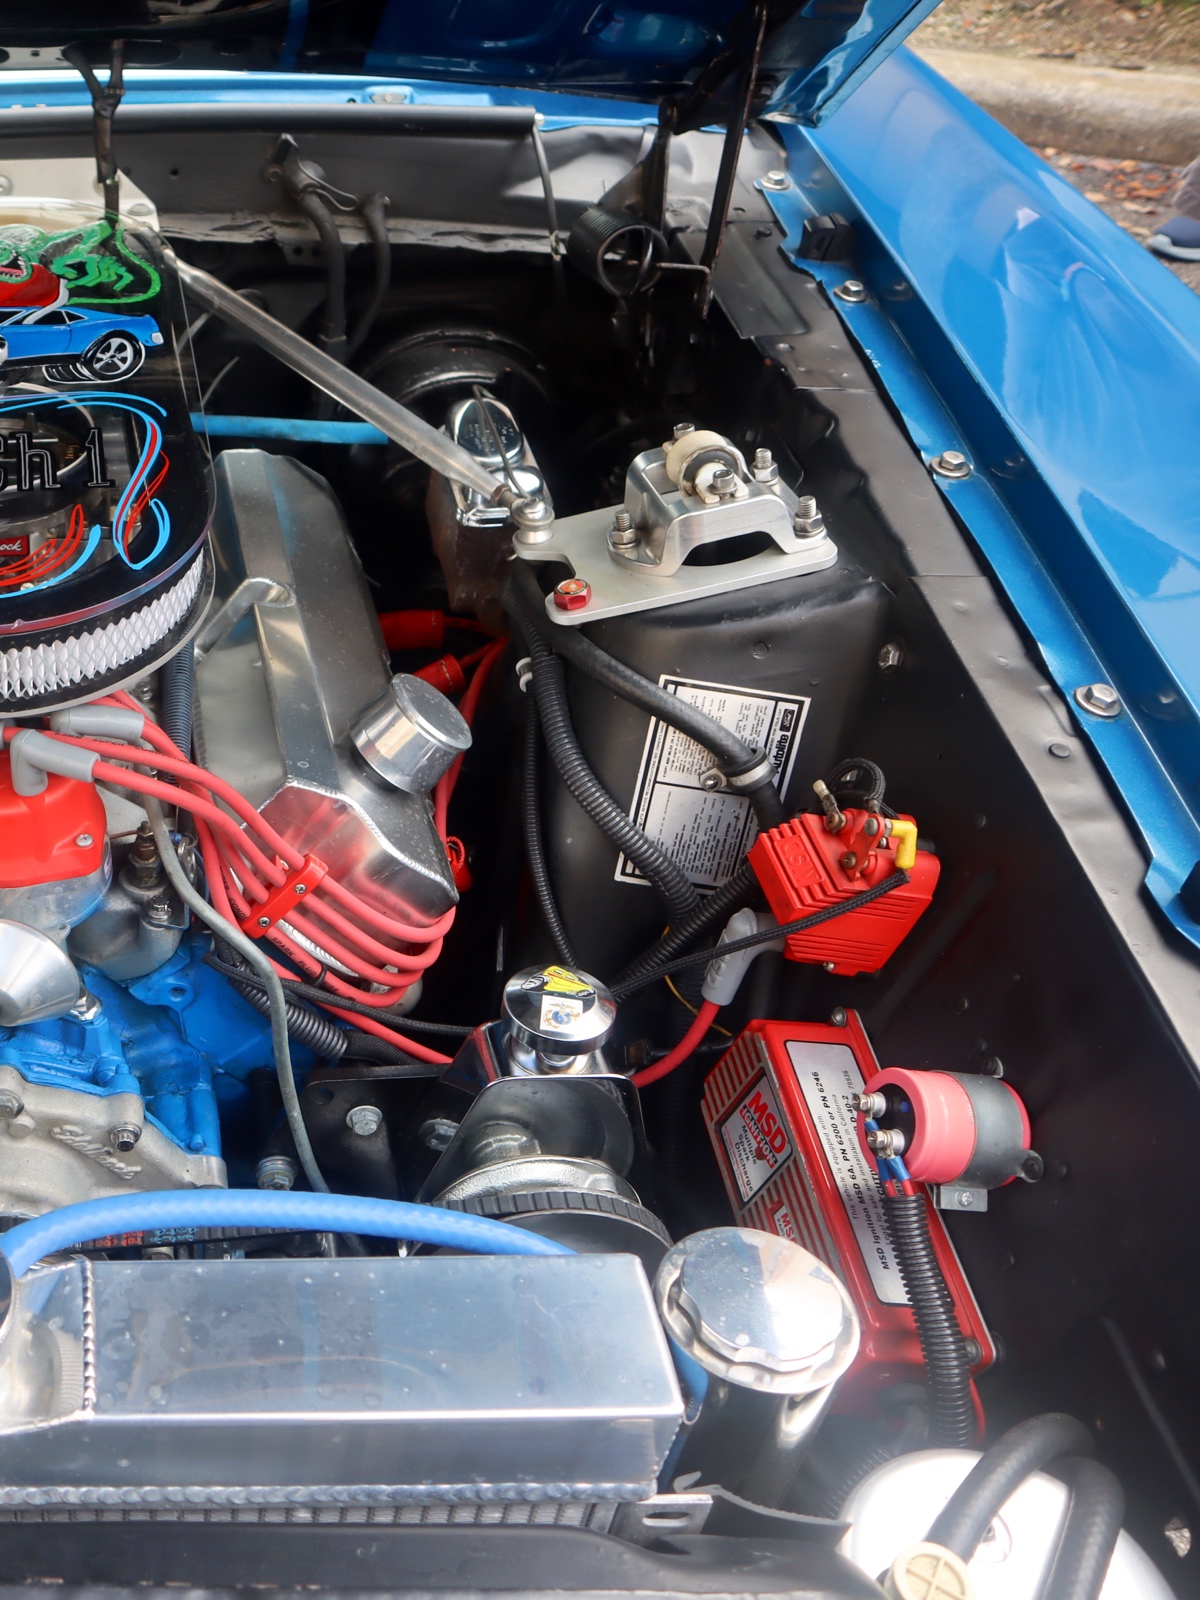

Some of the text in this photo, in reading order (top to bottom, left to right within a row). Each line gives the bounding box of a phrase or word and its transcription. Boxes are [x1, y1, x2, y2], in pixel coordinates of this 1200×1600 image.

[84, 429, 116, 488] 1
[782, 840, 821, 885] MSD
[270, 937, 295, 957] SPARK
[297, 960, 317, 977] PLUG
[842, 1069, 857, 1090] 79936
[748, 1091, 787, 1154] MSD
[832, 1093, 848, 1128] California
[841, 1095, 858, 1124] D-40-2
[738, 1133, 750, 1162] Spark
[740, 1107, 777, 1167] IGNITION
[741, 1125, 757, 1165] Multiple
[846, 1129, 852, 1137] in
[734, 1142, 753, 1192] Discharge
[811, 1071, 890, 1270] MSD Ignition MSD 6A, PN 6200 or PN 6246
[817, 1113, 860, 1220] This vehicle is equipped with:
[851, 1136, 865, 1176] installation
[872, 1193, 880, 1210] sale
[877, 1212, 885, 1227] for
